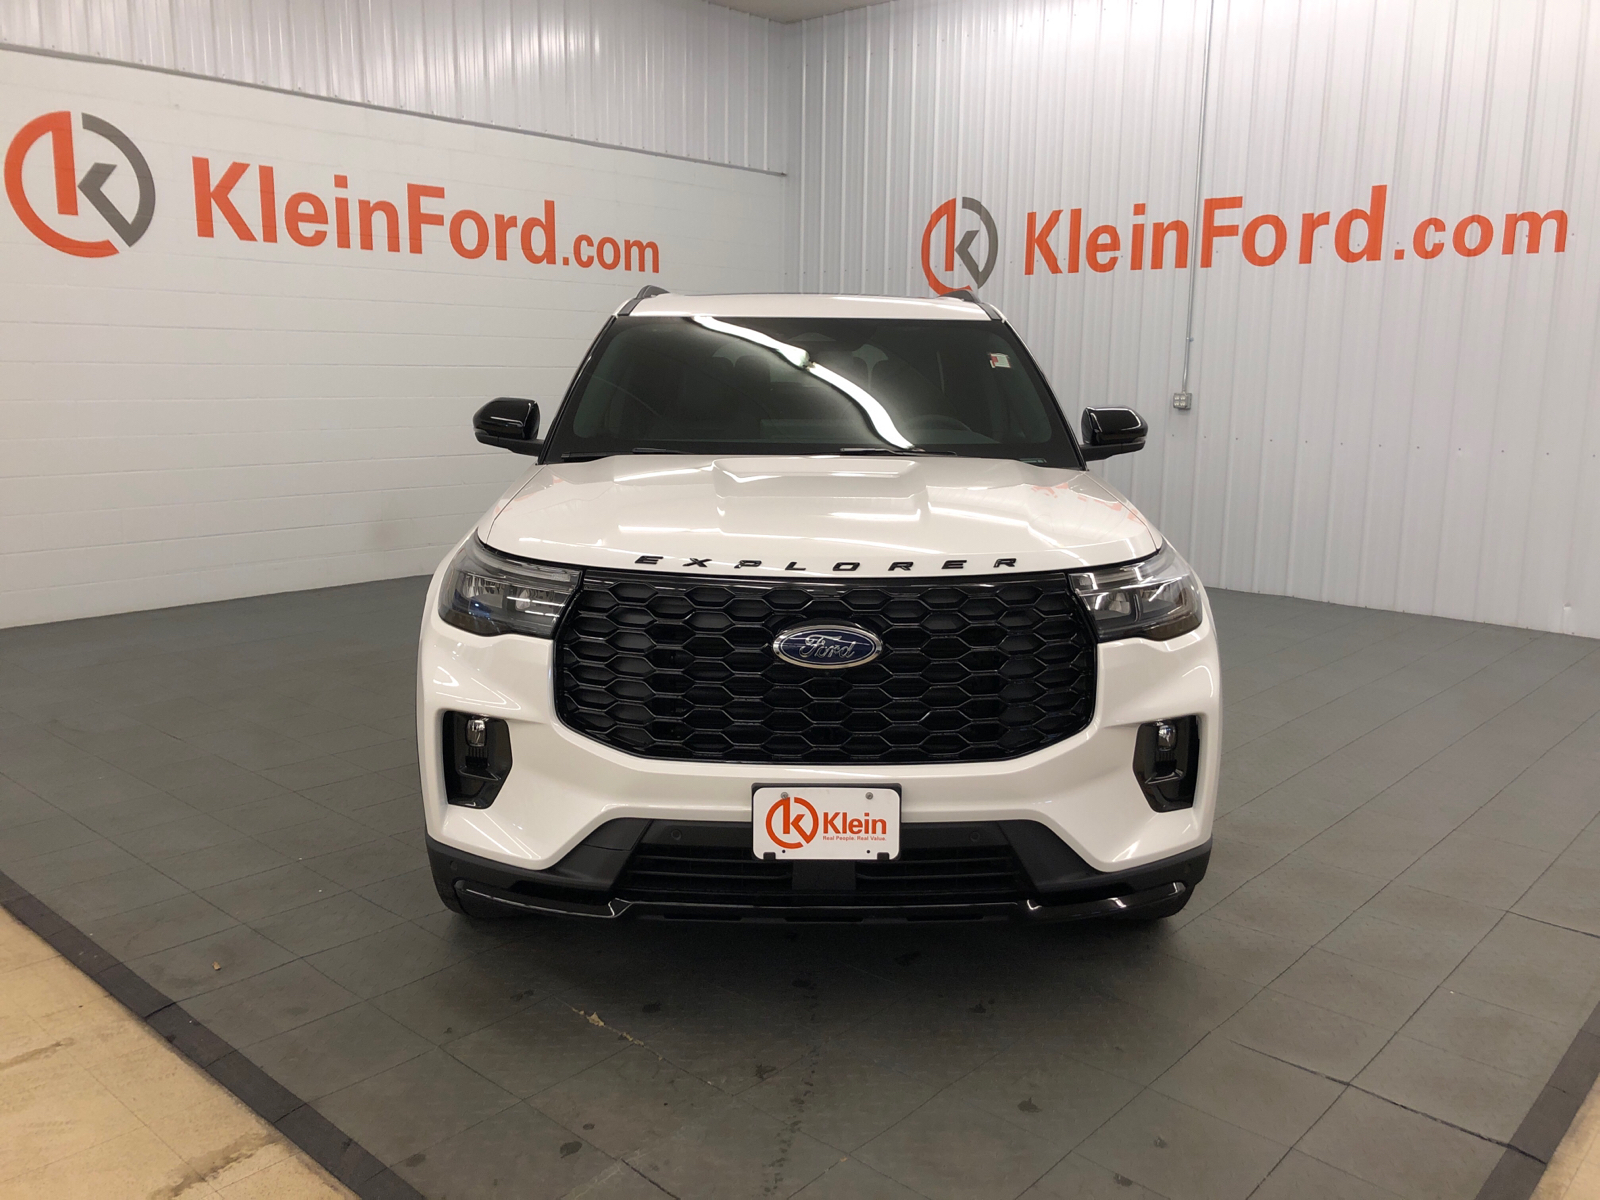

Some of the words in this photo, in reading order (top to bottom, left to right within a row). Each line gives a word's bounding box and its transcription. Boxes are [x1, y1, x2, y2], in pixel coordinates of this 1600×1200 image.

[191, 156, 661, 275] KleinFord.com
[1024, 184, 1569, 276] KleinFord.com
[634, 555, 1018, 573] EXPLORER
[799, 634, 857, 658] Ford
[822, 811, 887, 835] Klein
